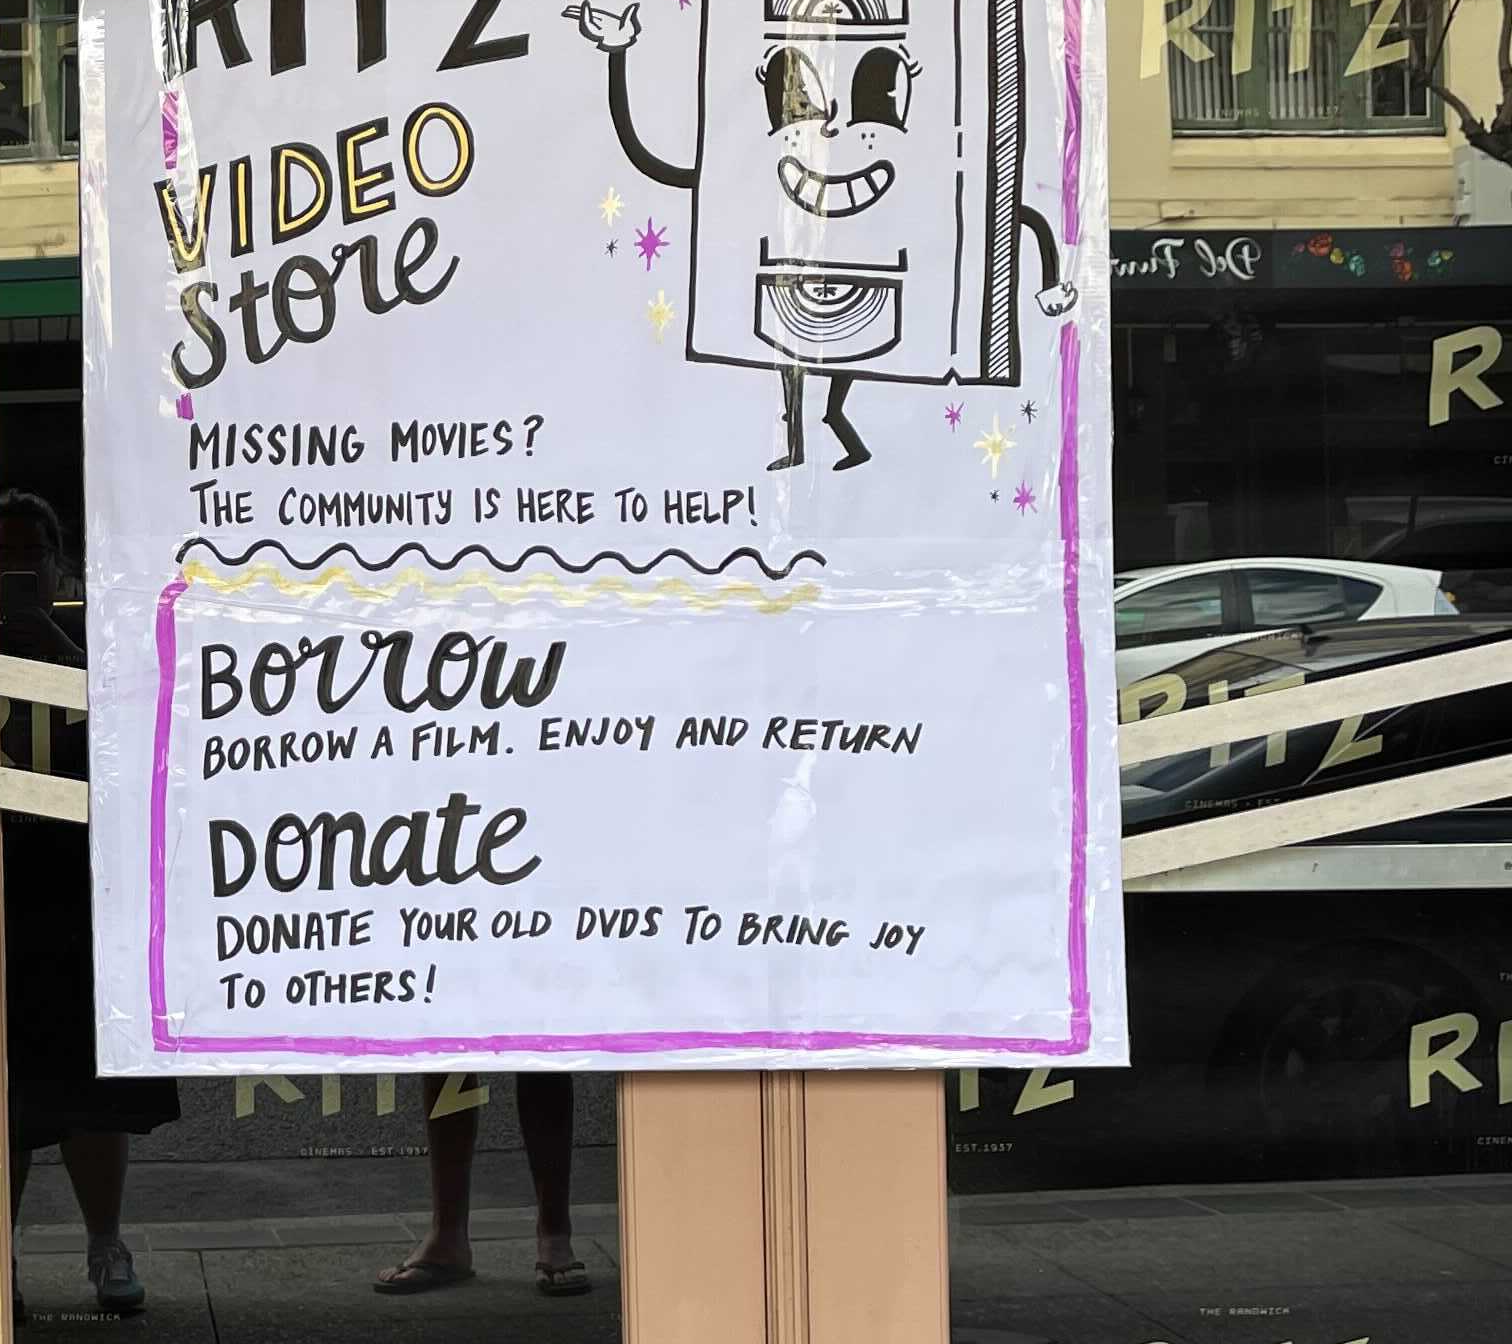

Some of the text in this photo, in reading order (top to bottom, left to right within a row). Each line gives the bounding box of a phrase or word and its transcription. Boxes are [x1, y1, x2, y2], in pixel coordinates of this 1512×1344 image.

[154, 102, 474, 274] VIDEO
[168, 215, 460, 390] Store
[188, 415, 543, 466] MISSING MOVIES?
[190, 479, 757, 526] THE COMMUNITY IS HERE TO HELP!
[200, 631, 568, 722] Borrow
[204, 717, 921, 779] BORROW A FILM. ENJOY AND RETURN
[209, 794, 541, 897] Donate
[217, 906, 924, 961] DONATE YOUR OLD DVDS TO BRING JOY
[220, 965, 435, 1009] TO OTHERS!
[32, 1312, 121, 1321] THE RANDWICK
[1199, 1306, 1290, 1316] THE RANDWICK
